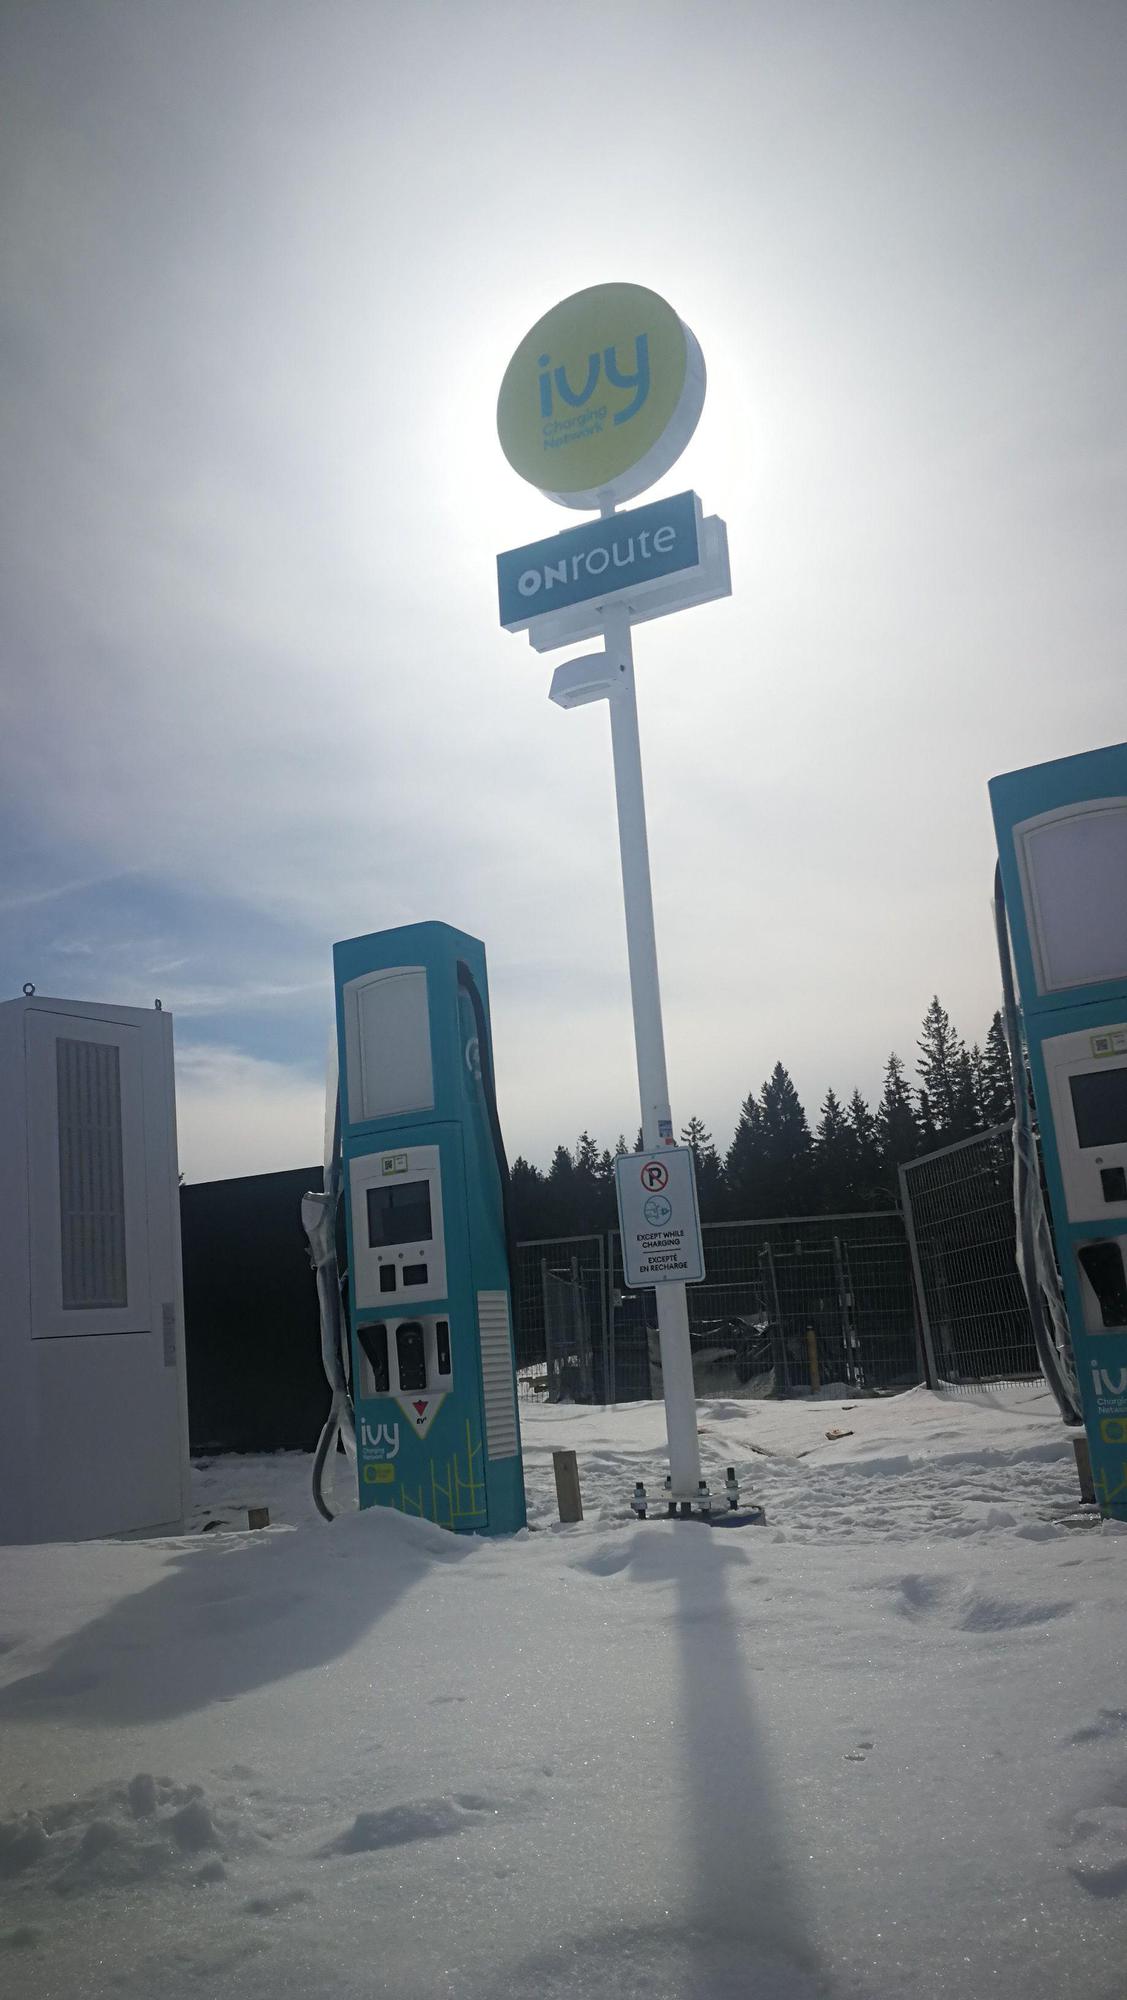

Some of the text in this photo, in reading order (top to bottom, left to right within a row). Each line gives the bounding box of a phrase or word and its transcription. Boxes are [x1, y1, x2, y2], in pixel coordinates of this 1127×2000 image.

[538, 332, 651, 426] ivy
[543, 405, 607, 436] Charging
[543, 424, 603, 451] Network
[636, 1229, 685, 1242] EXCEPT WHILE
[642, 1238, 681, 1249] CHARGING
[639, 1261, 688, 1273] EN RECHARGE
[1090, 1359, 1127, 1395] iv
[361, 1417, 400, 1459] ivy
